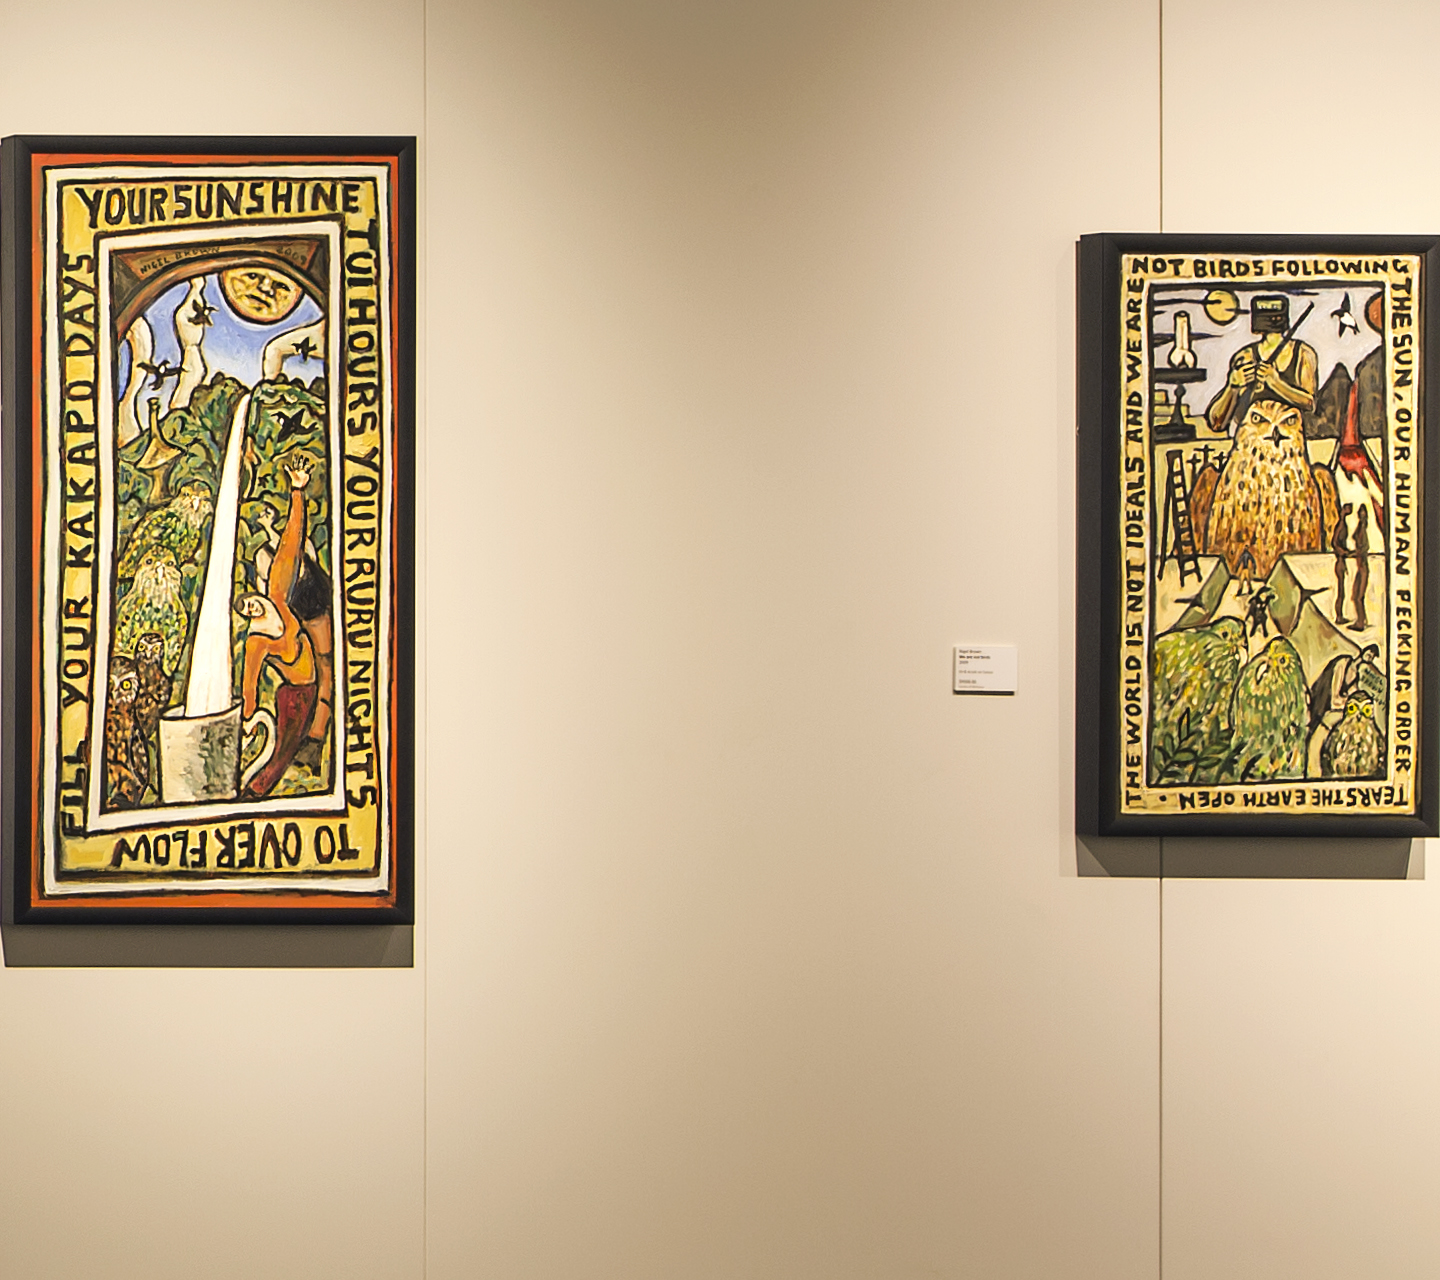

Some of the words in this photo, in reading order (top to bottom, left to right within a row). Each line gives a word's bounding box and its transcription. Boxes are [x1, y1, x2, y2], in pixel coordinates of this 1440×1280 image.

[345, 219, 379, 287] TUI
[1132, 256, 1185, 276] NOT
[1193, 259, 1264, 279] BIRDS
[1272, 258, 1410, 276] FOLLOWING
[62, 253, 97, 357] DAYS
[1126, 277, 1145, 333] ARE
[1391, 277, 1413, 330] THE
[346, 298, 379, 436] HOURS
[1126, 339, 1144, 381] WE
[1125, 391, 1144, 443] AND
[1394, 408, 1413, 462] OUR
[66, 381, 96, 568] KAKAPO
[345, 447, 380, 551] YOUR
[1125, 456, 1144, 549] IDEALS
[1394, 472, 1412, 575] HUMAN
[345, 558, 376, 649] RURU
[1126, 562, 1145, 612] NOT
[62, 595, 92, 708] YOUR
[1125, 621, 1143, 648] IS
[1394, 590, 1413, 693] PECKING
[1124, 660, 1143, 746] WORLD
[346, 660, 377, 809] NIGHTS
[1394, 700, 1412, 772] ORDER
[62, 740, 88, 836] FILL
[1124, 755, 1142, 807] THE
[1180, 790, 1236, 810] OPEN
[1243, 788, 1307, 808] EARTH
[1311, 788, 1346, 807] THE
[1346, 786, 1410, 807] TEARS
[314, 823, 361, 864] TO
